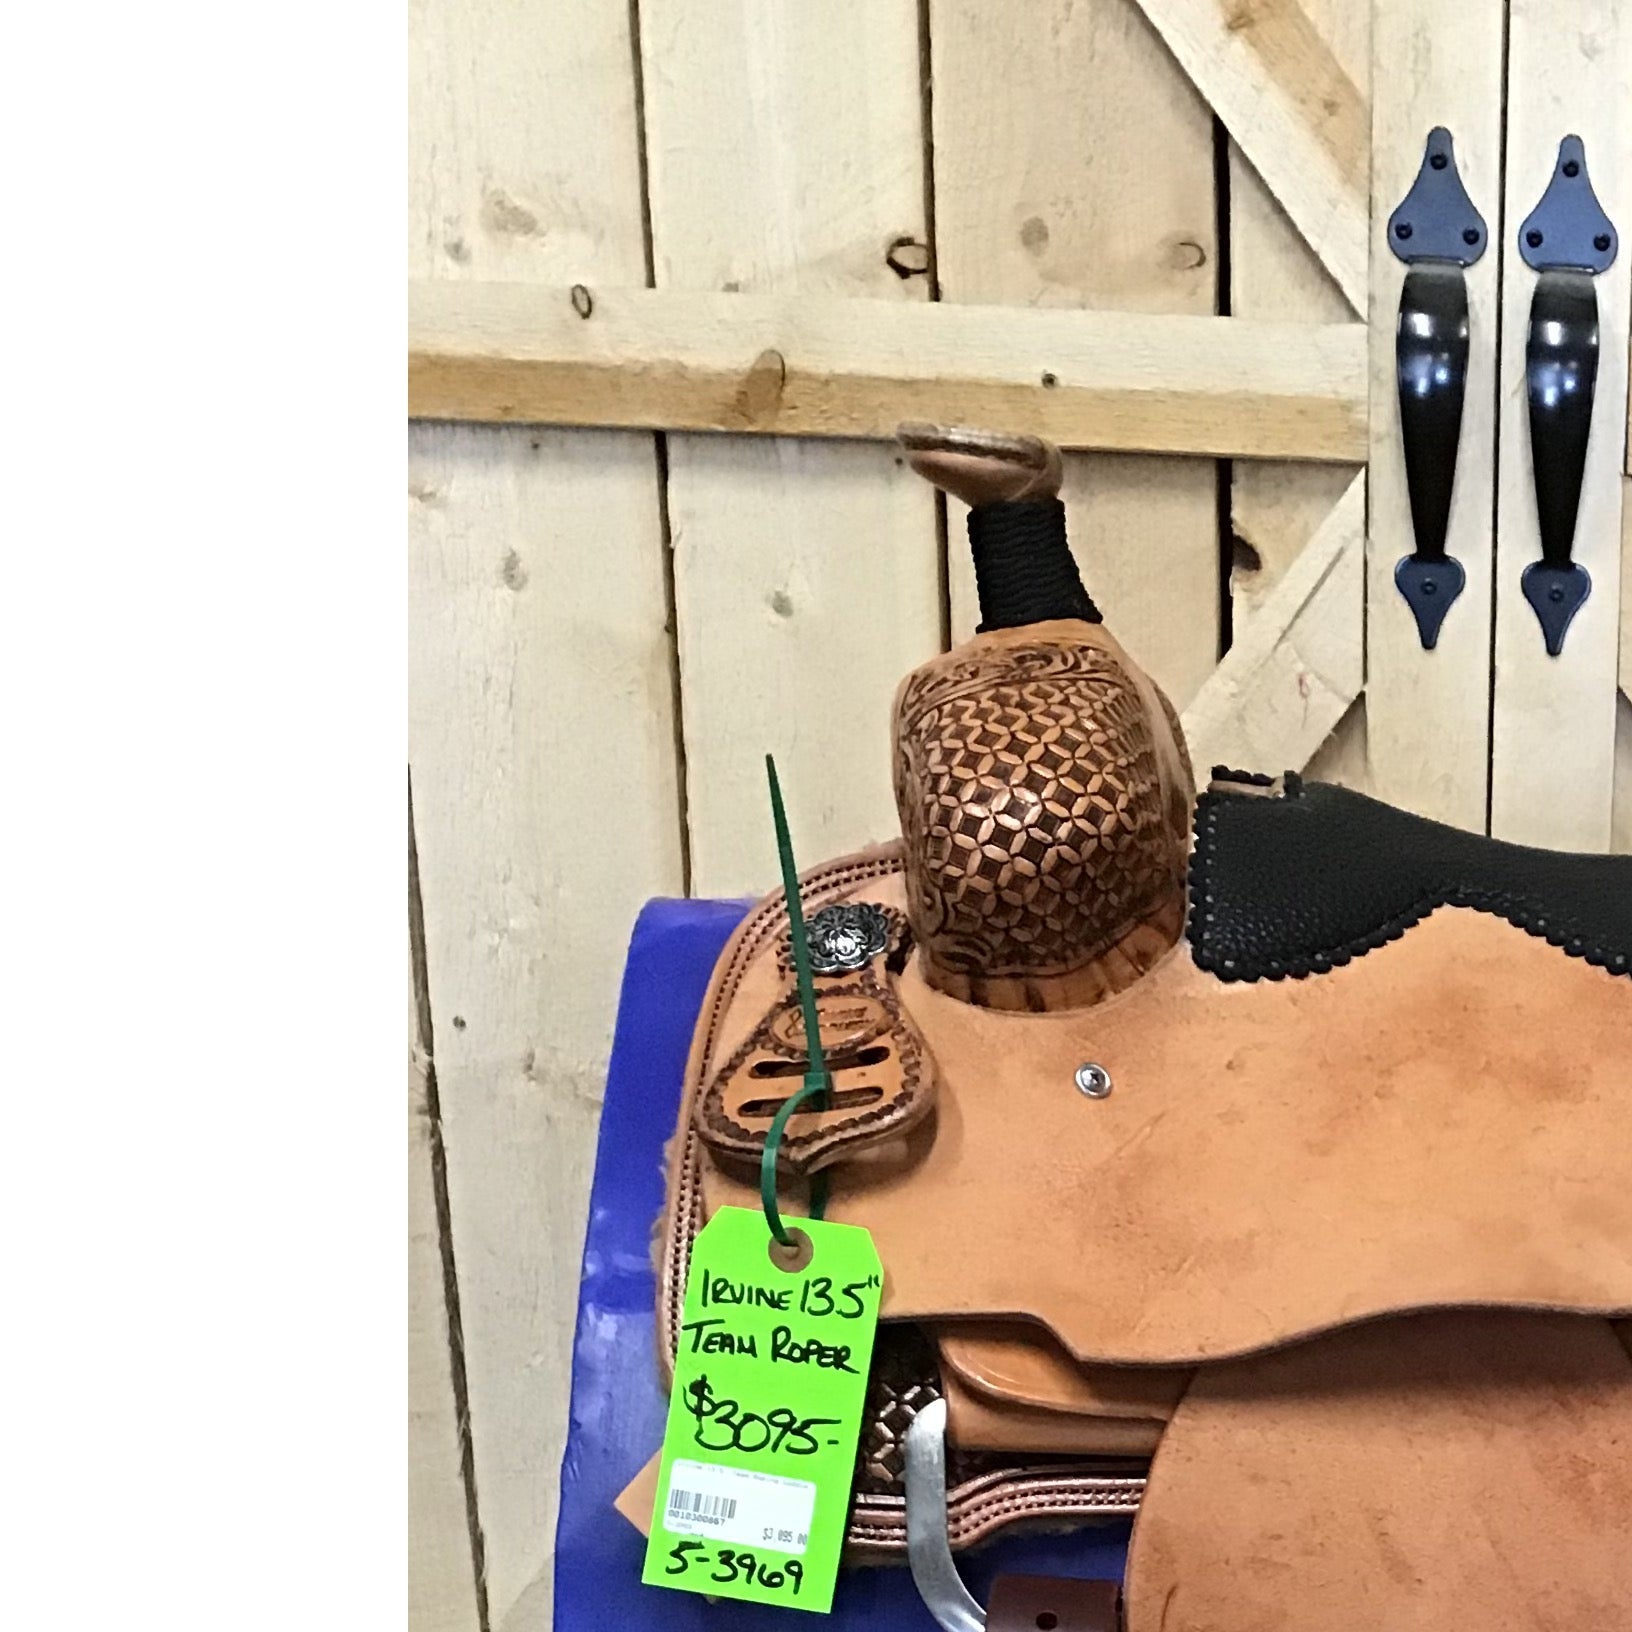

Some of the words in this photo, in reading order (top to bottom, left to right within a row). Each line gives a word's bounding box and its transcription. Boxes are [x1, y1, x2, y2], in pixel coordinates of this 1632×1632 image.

[701, 1269, 793, 1311] IRVINE
[681, 1319, 758, 1358] TEAM
[771, 1325, 860, 1374] ROPER
